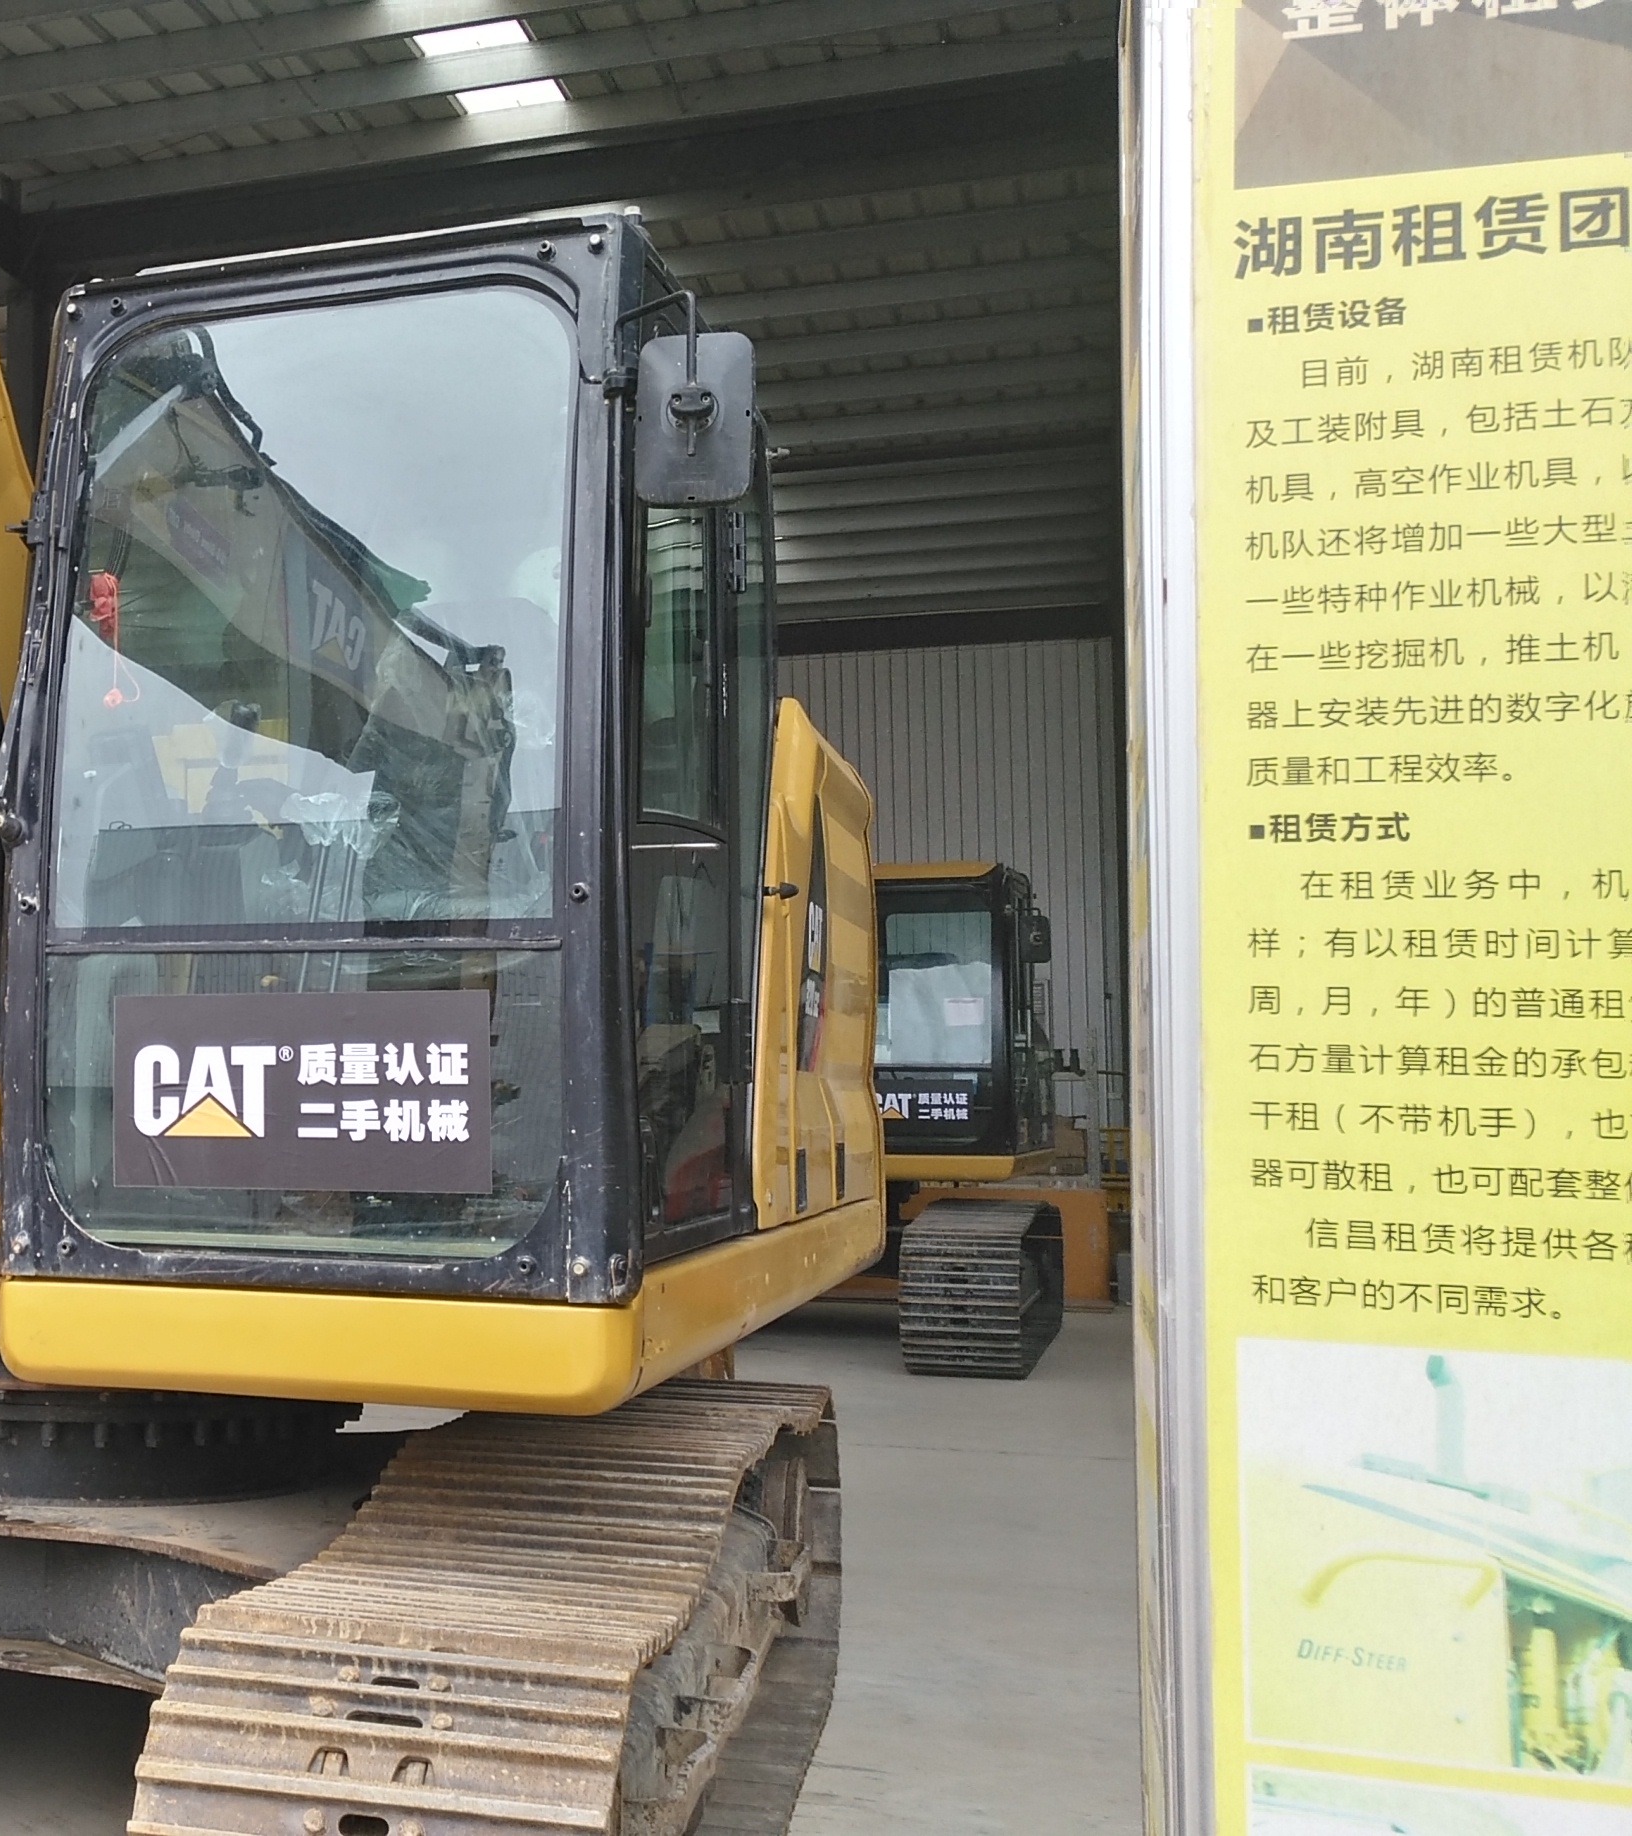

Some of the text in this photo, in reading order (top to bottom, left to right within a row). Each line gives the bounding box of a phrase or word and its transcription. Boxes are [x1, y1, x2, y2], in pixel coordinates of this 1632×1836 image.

[1233, 185, 1631, 280] 湖南租赁团
[1267, 297, 1407, 335] 租赁设备
[1244, 454, 1632, 505] 机具，高空作业机具，
[1245, 571, 1632, 616] 一些特种作业机械，以
[1246, 688, 1632, 730] 器上安装先进的数字化
[1246, 752, 1515, 788] 质量和工程效率。
[1268, 812, 1411, 844] 租赁方式
[1248, 985, 1632, 1021] 周，月，年）的普通租
[297, 1042, 469, 1086] 质量认证
[1248, 1043, 1632, 1080] 石方量计算租金的承包
[918, 1093, 968, 1105] 质量认证
[918, 1108, 968, 1120] 二手机械
[297, 1100, 470, 1142] 二手机械
[1249, 1101, 1632, 1140] 干租（不带机手），也
[1250, 1158, 1632, 1203] 器可散租，也可配套整
[1251, 1273, 1562, 1321] 和客户的不同需求。
